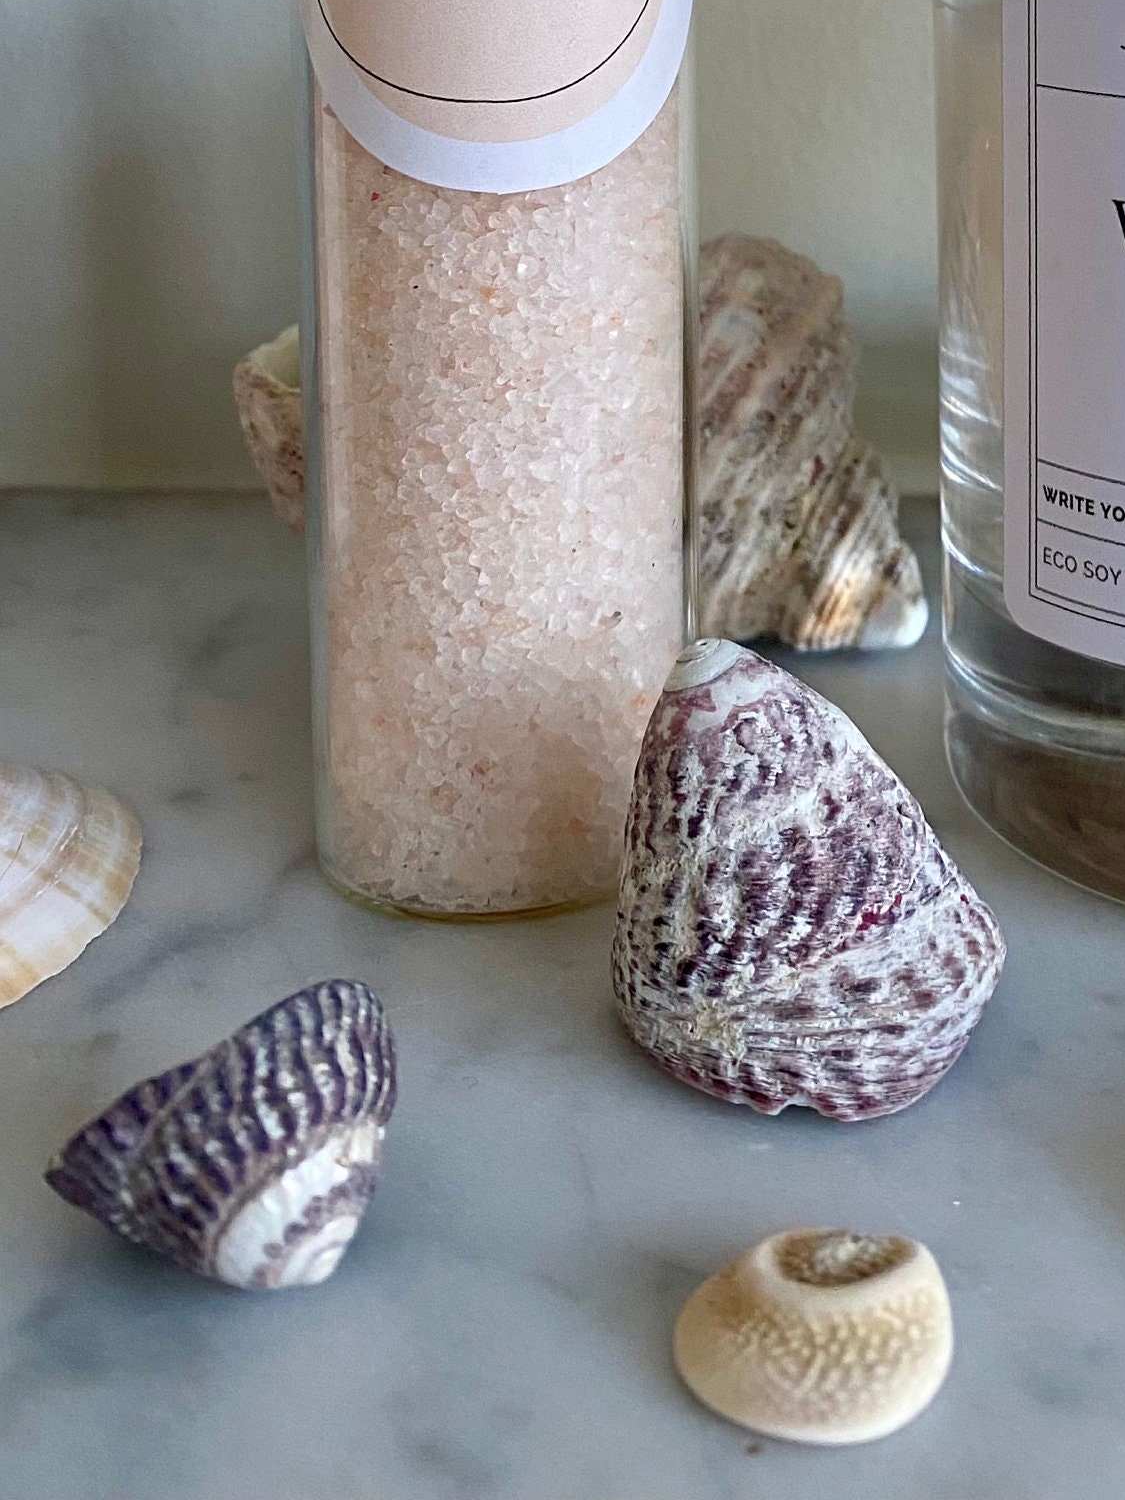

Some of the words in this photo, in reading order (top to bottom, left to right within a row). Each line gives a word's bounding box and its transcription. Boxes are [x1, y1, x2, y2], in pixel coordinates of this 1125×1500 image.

[1042, 484, 1095, 516] WRITE
[1043, 546, 1078, 574] ECO
[1082, 560, 1122, 586] SOY
